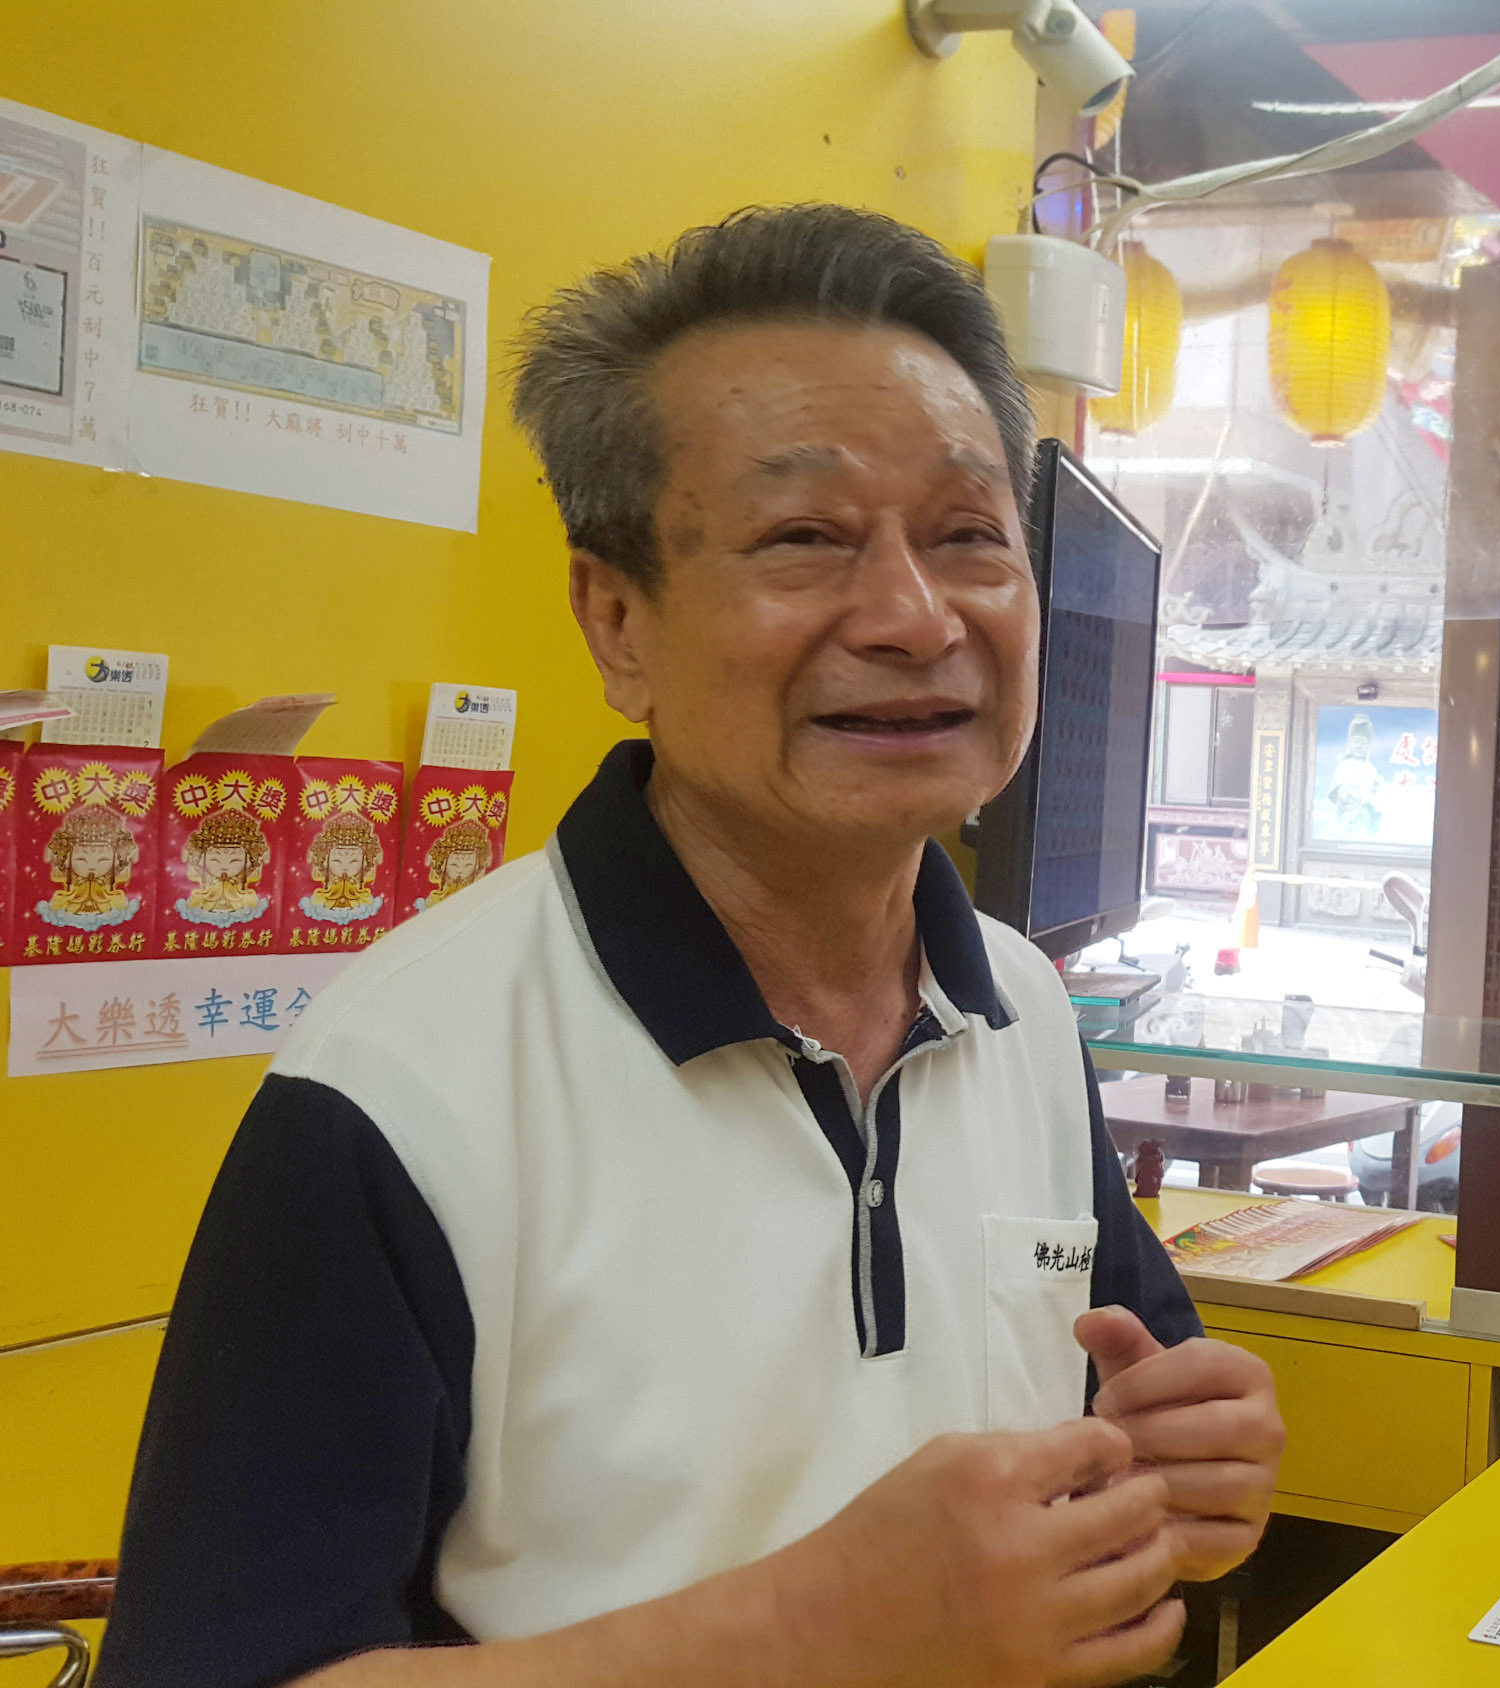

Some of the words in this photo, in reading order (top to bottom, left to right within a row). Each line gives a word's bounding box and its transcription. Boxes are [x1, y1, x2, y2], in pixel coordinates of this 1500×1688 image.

[41, 772, 152, 810] 中大獎
[180, 779, 285, 814] 中大獎
[305, 784, 395, 817] 中大獎
[427, 793, 505, 822] 中大獎
